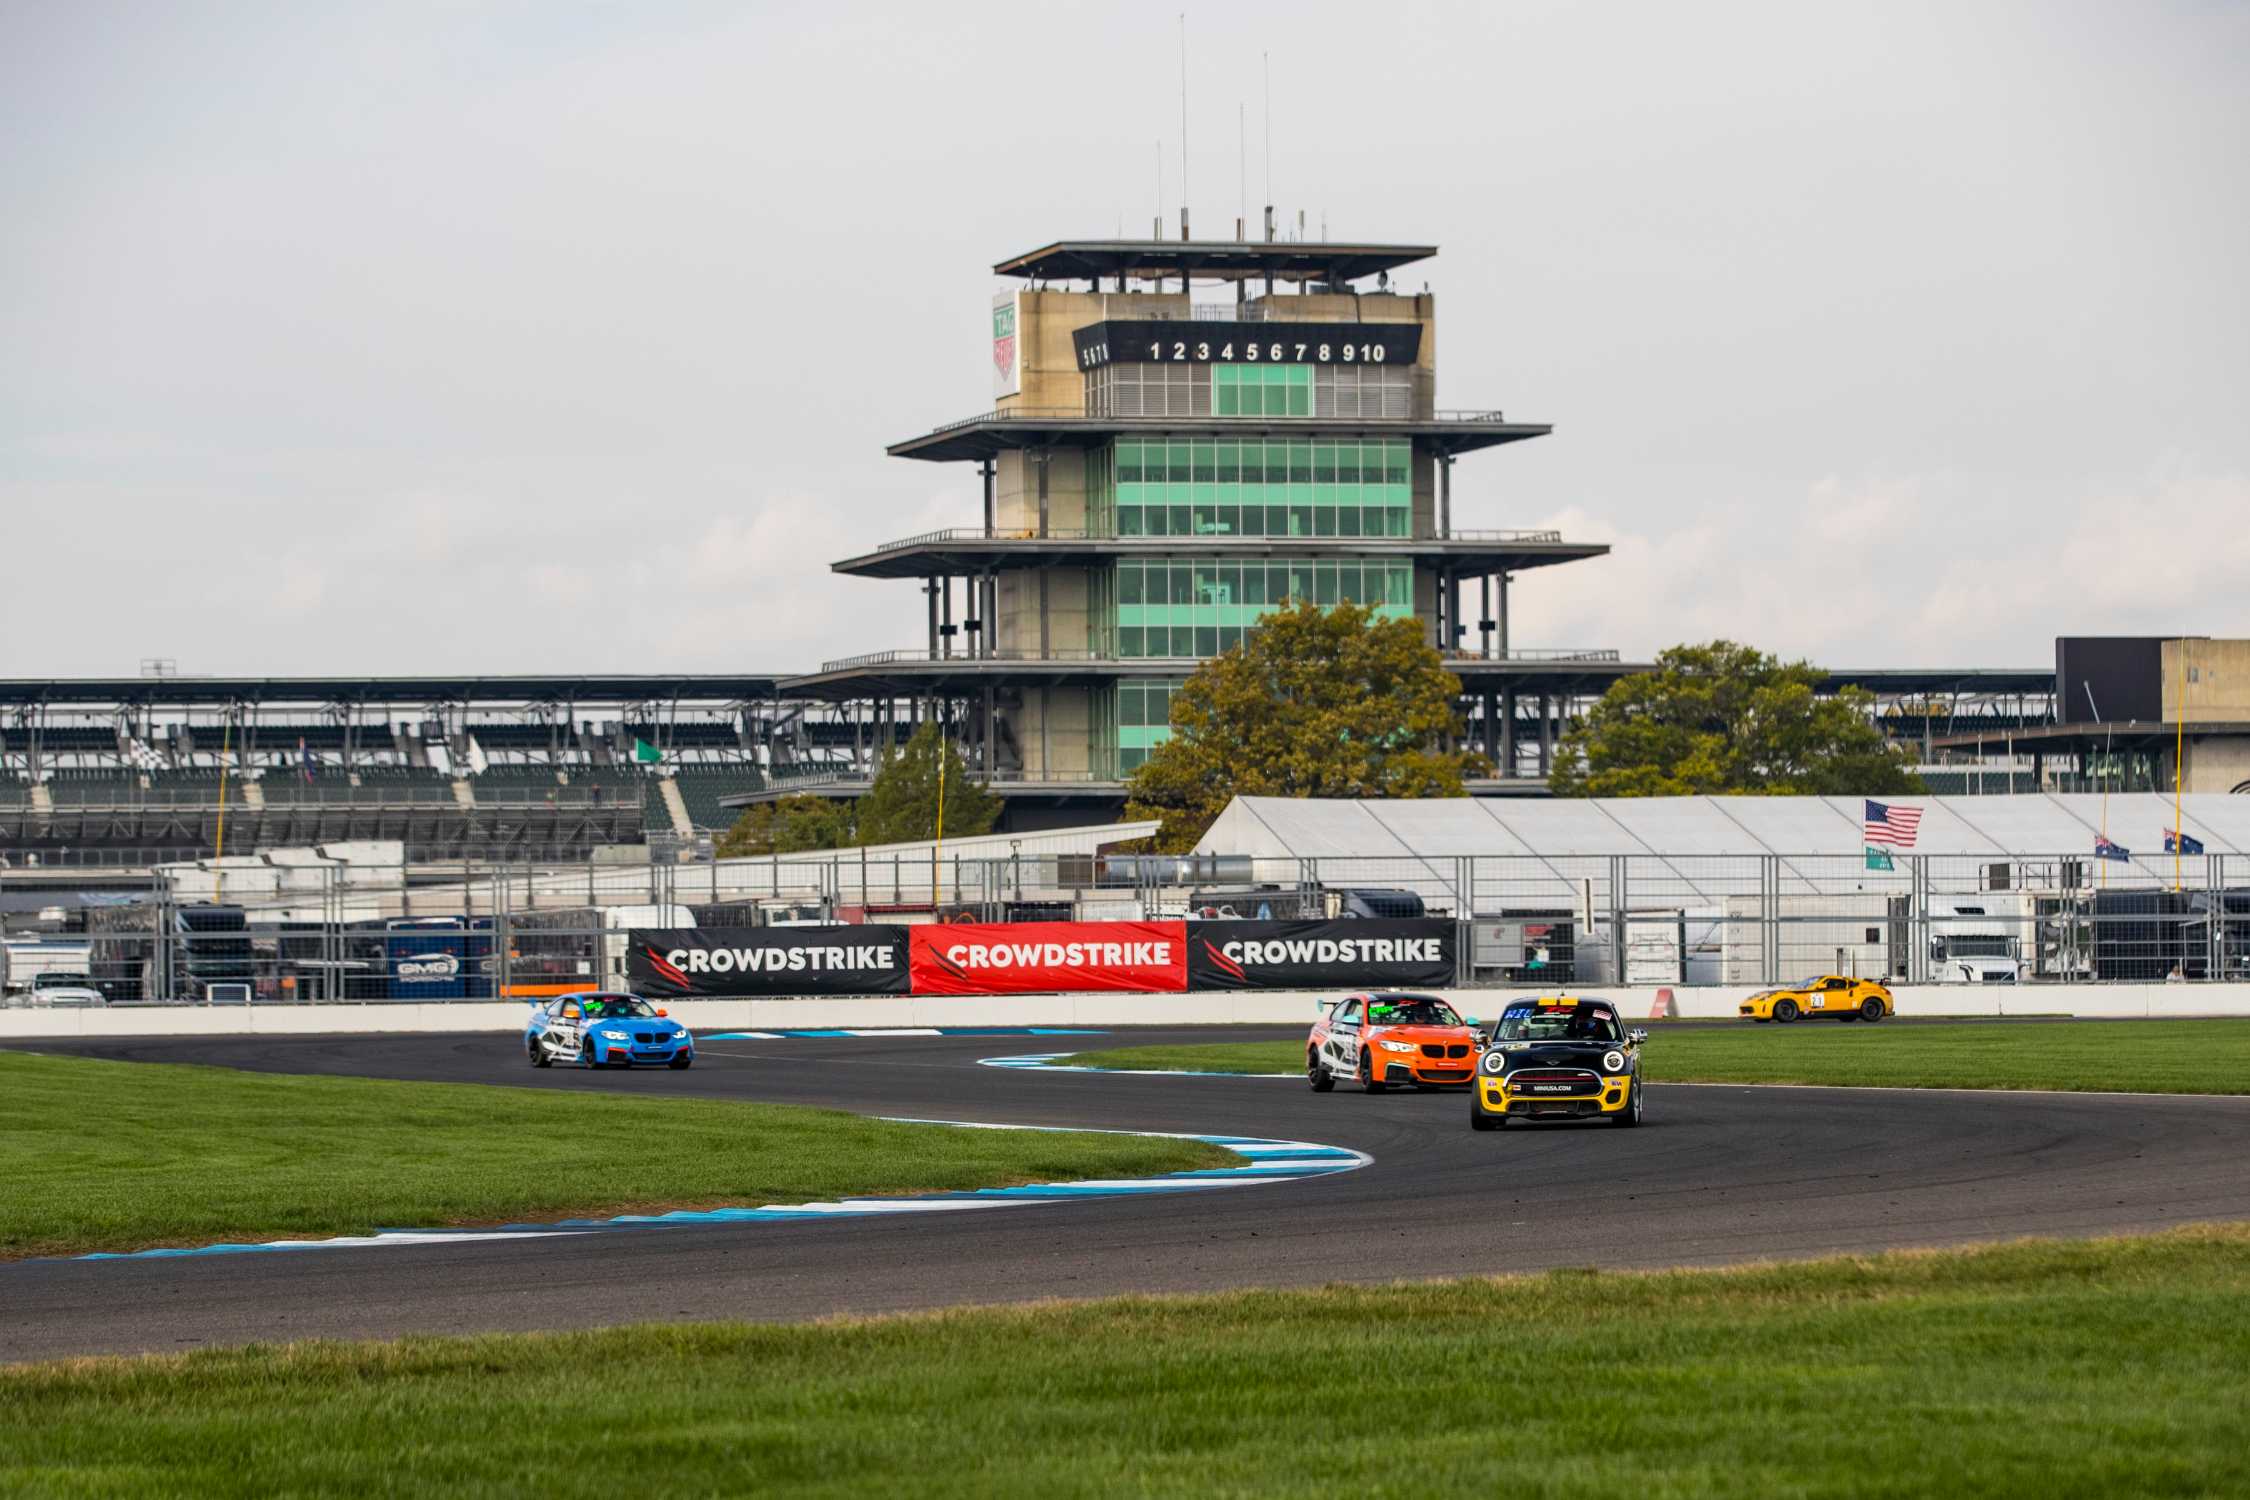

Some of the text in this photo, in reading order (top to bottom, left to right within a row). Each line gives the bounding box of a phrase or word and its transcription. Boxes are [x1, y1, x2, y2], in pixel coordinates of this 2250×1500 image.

[1151, 342, 1385, 362] 1 2 3 4 5 6 7 8 9 10
[666, 946, 894, 973] CROWDSTRIKE
[947, 942, 1171, 968] CROWDSTRIKE
[1222, 938, 1442, 965] CROWDSTRIKE
[398, 962, 449, 974] GMG
